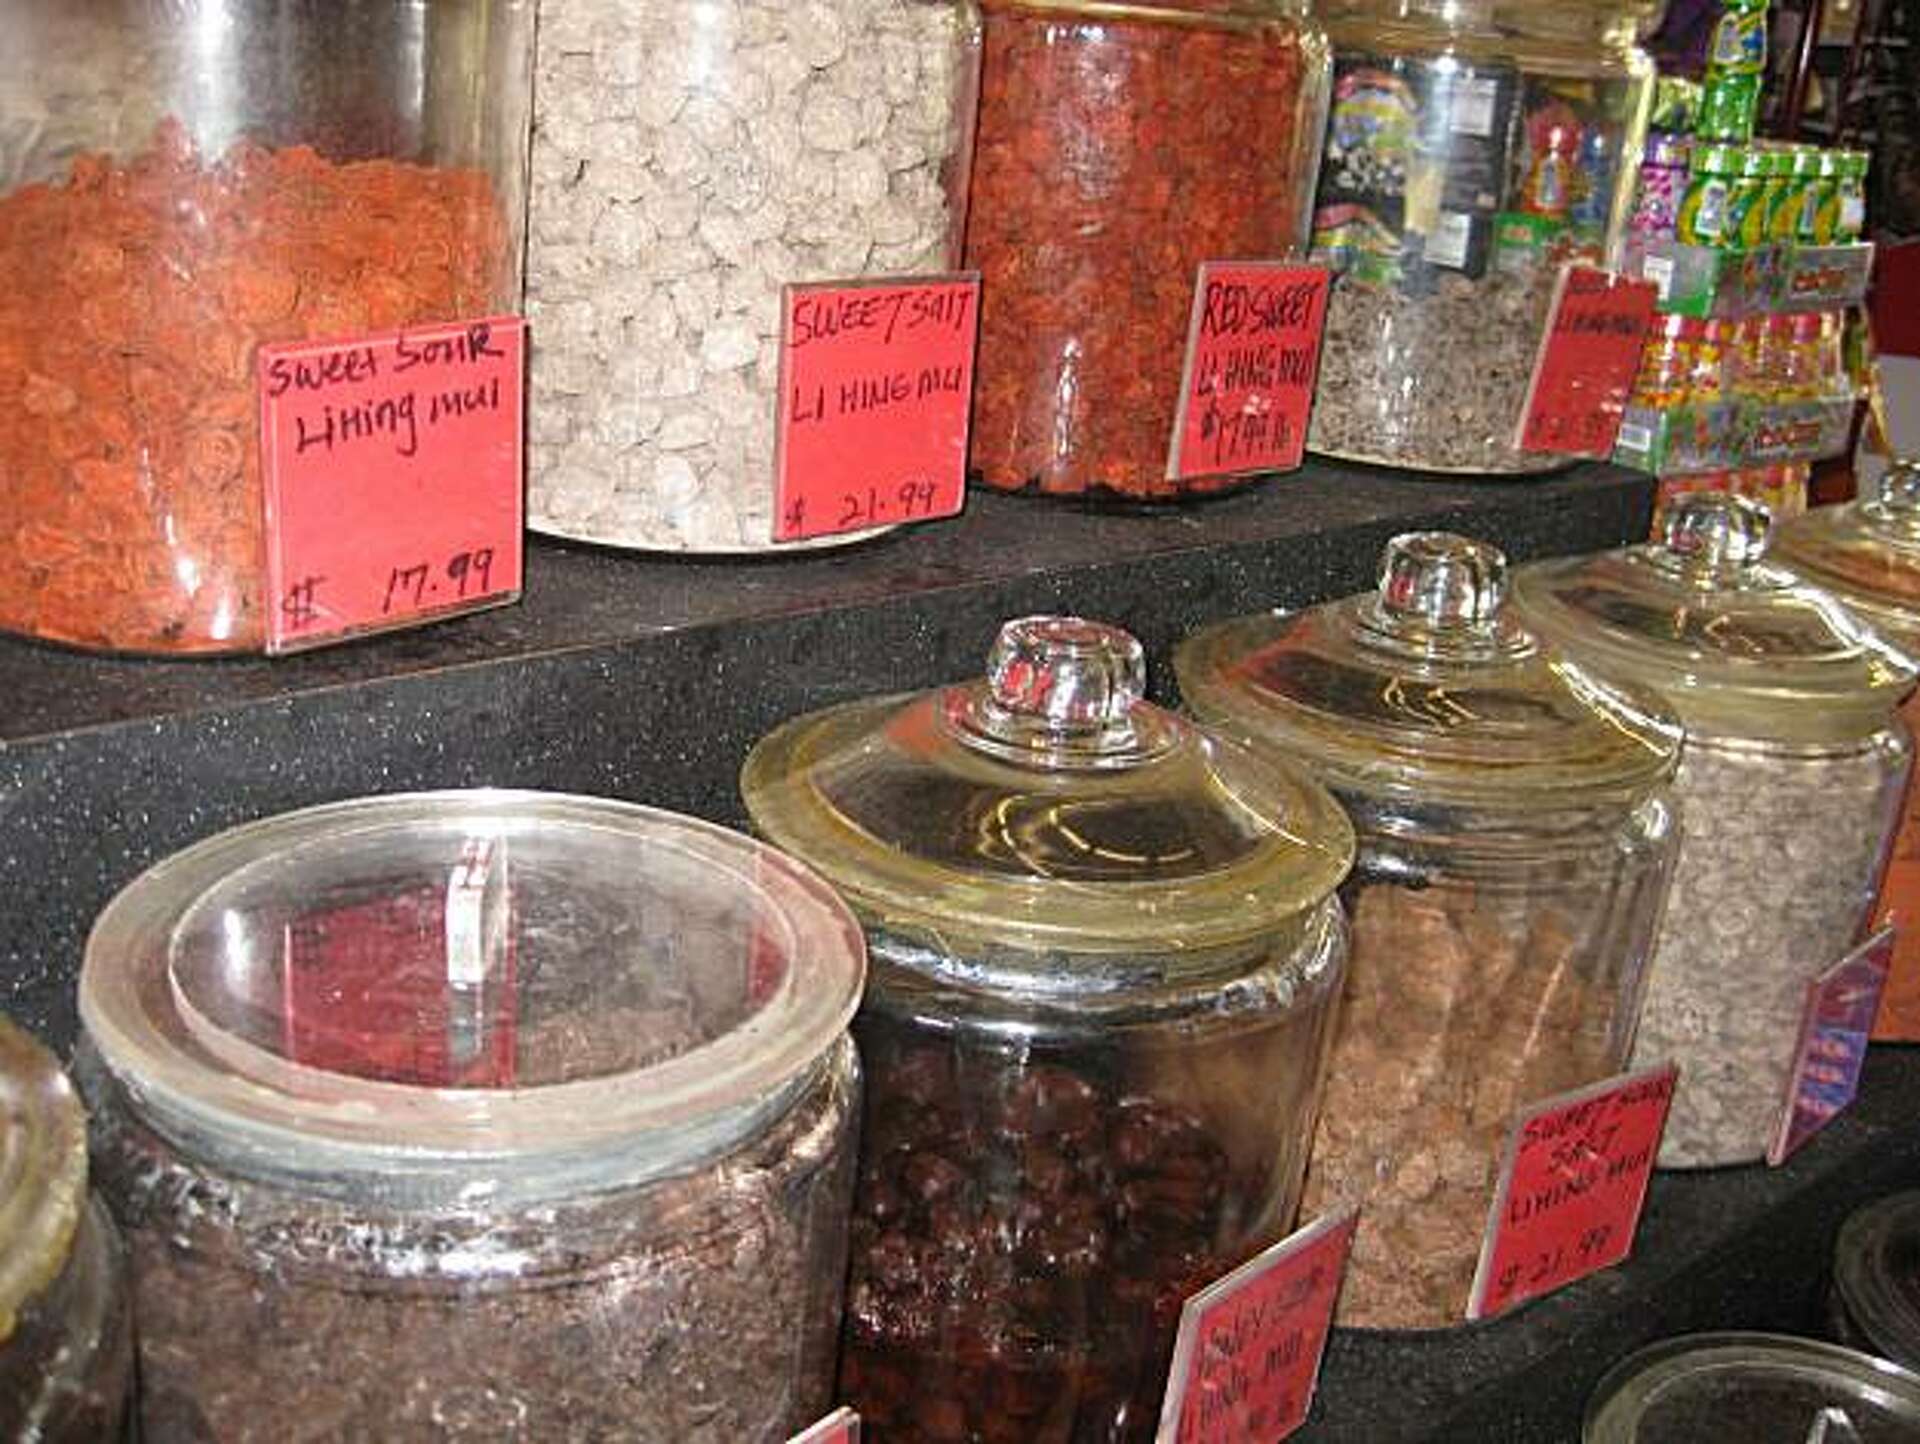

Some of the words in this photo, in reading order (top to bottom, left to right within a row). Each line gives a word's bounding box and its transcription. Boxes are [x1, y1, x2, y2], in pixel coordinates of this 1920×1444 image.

[788, 290, 903, 348] SWEET
[792, 386, 825, 422] LI
[838, 374, 908, 414] HING
[382, 547, 494, 614] 17.99
